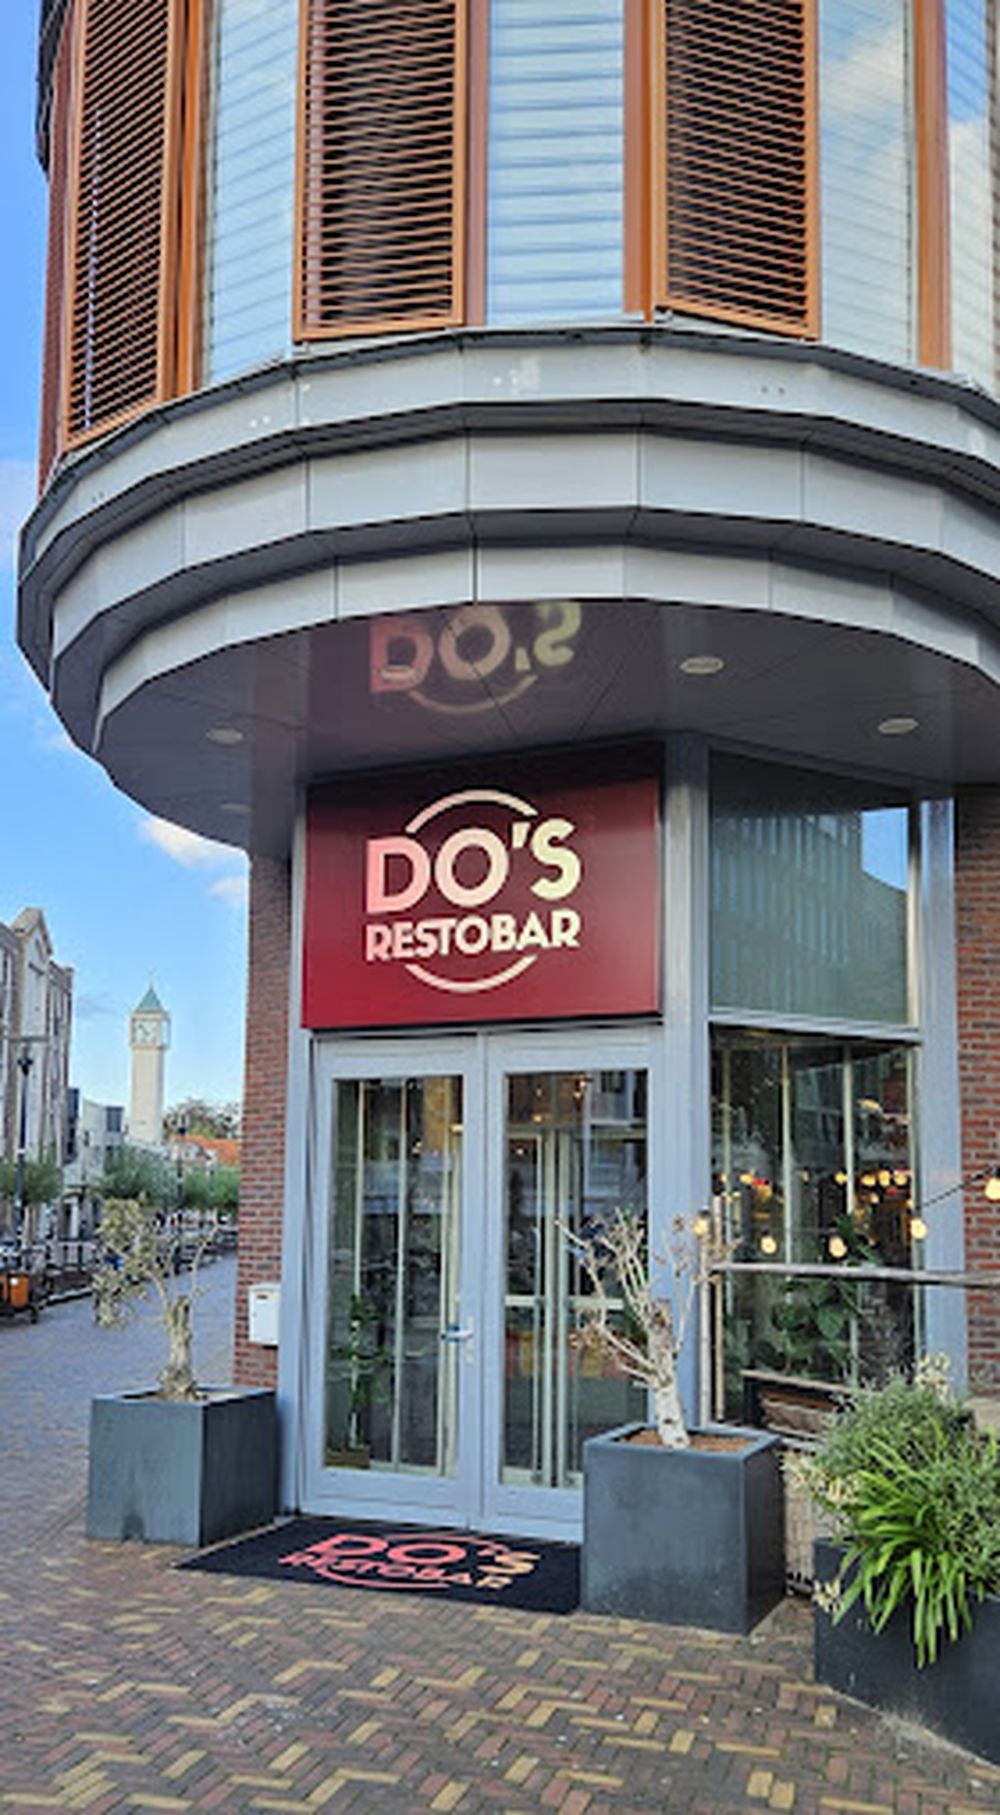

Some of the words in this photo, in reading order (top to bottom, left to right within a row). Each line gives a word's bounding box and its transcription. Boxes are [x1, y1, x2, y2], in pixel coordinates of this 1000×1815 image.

[366, 818, 582, 914] DO'S
[365, 909, 581, 962] RESTOBAR
[277, 1552, 513, 1590] RESTOBAR
